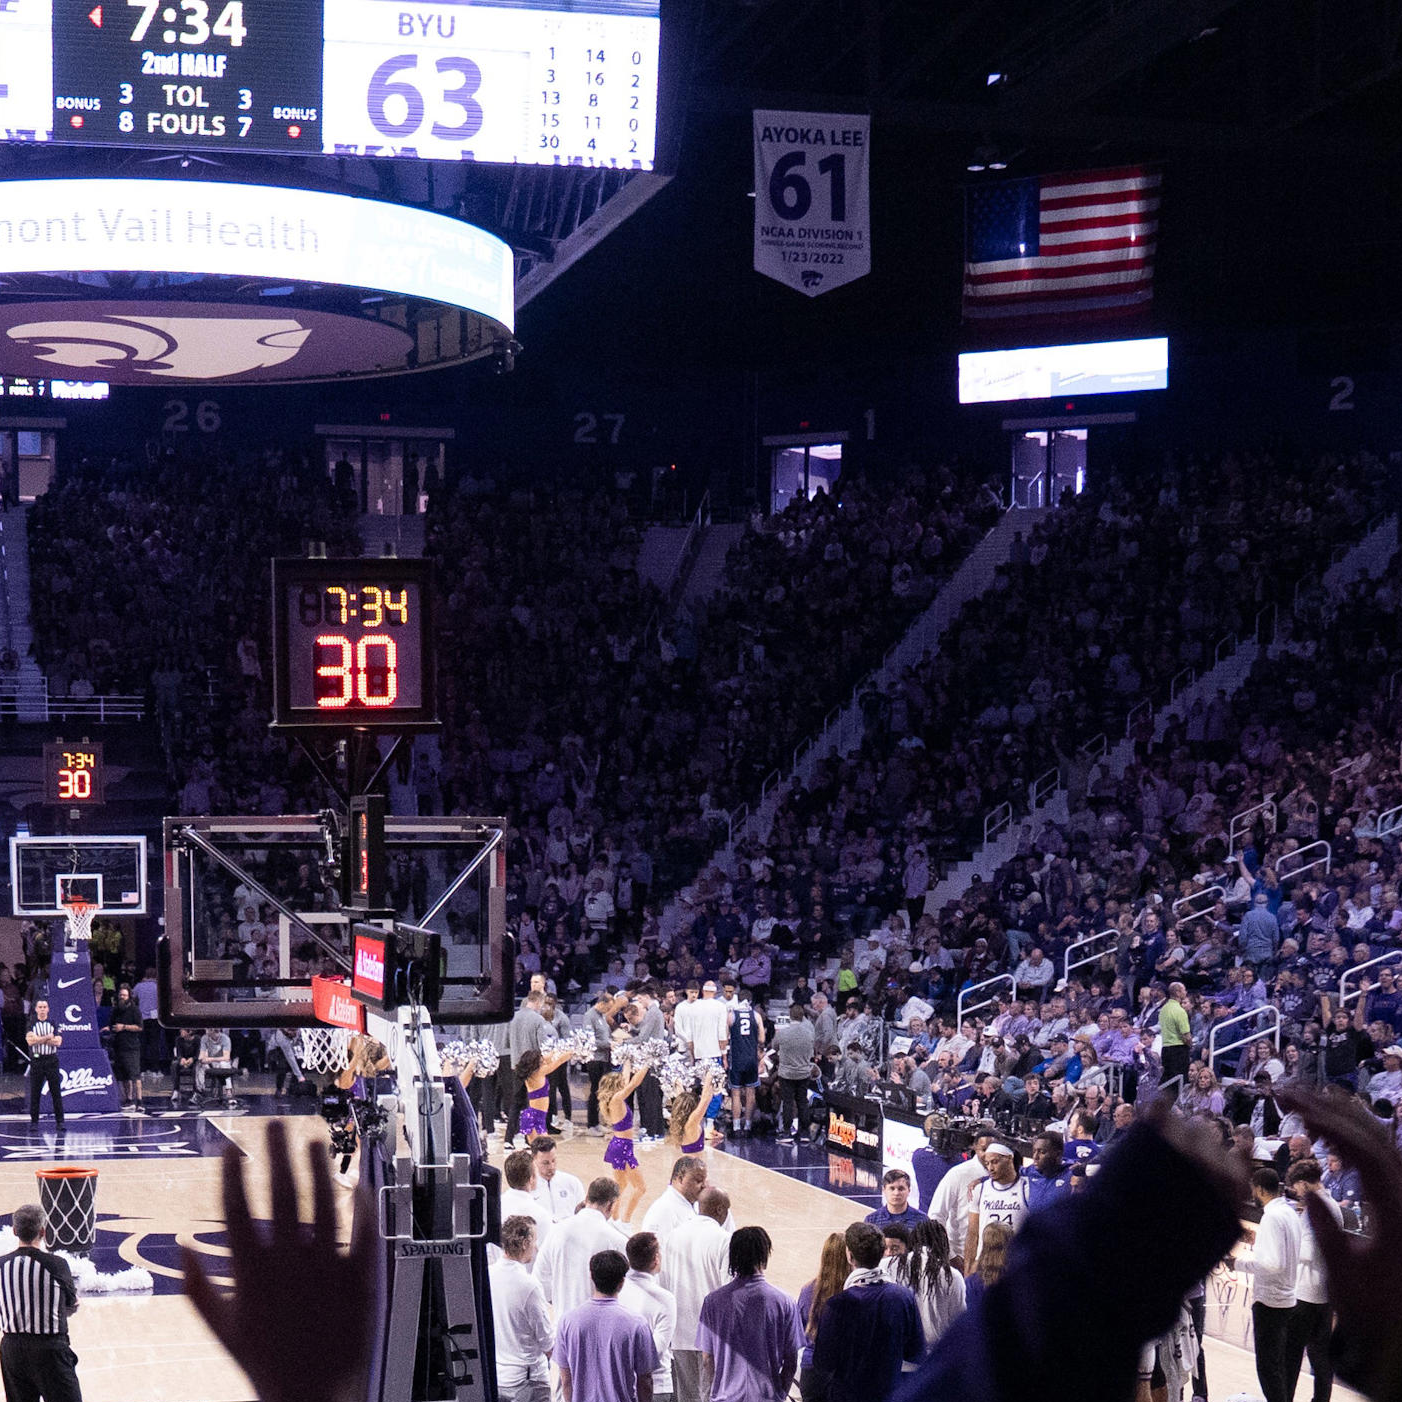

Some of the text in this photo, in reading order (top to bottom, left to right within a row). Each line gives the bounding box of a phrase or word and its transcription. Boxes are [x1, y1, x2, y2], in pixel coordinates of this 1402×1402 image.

[127, 0, 248, 46] 7:34
[398, 13, 456, 38] BYU
[141, 51, 227, 77] 2nd HALF
[549, 47, 641, 65] 1 14 0
[547, 70, 640, 87] 3 16 2
[56, 97, 101, 110] BONUS
[119, 83, 252, 110] 3 TOL 3
[367, 54, 483, 141] 63
[542, 92, 639, 109] 13 8 2
[119, 111, 252, 137] 8 FOULS 7
[273, 107, 317, 121] BONUS
[541, 114, 638, 132] 15 11 0
[539, 136, 637, 153] 30 4 2
[761, 127, 863, 147] AYOKA LEE
[769, 151, 845, 221] 61
[98, 207, 172, 246] Vail
[187, 210, 318, 253] Health
[761, 226, 795, 238] NCAA
[798, 227, 853, 241] DIVISION
[781, 251, 844, 264] 1/23/2022
[1329, 376, 1355, 410] 2
[163, 399, 221, 432] 26
[574, 412, 625, 444] 27
[864, 408, 876, 441] 1
[327, 586, 408, 627] 7:34
[317, 635, 397, 707] 30
[62, 752, 95, 769] 7:34
[58, 769, 91, 798] 30
[740, 1019, 750, 1035] 2
[984, 1200, 1020, 1210] Wildcats
[401, 1242, 464, 1257] SPALDING
